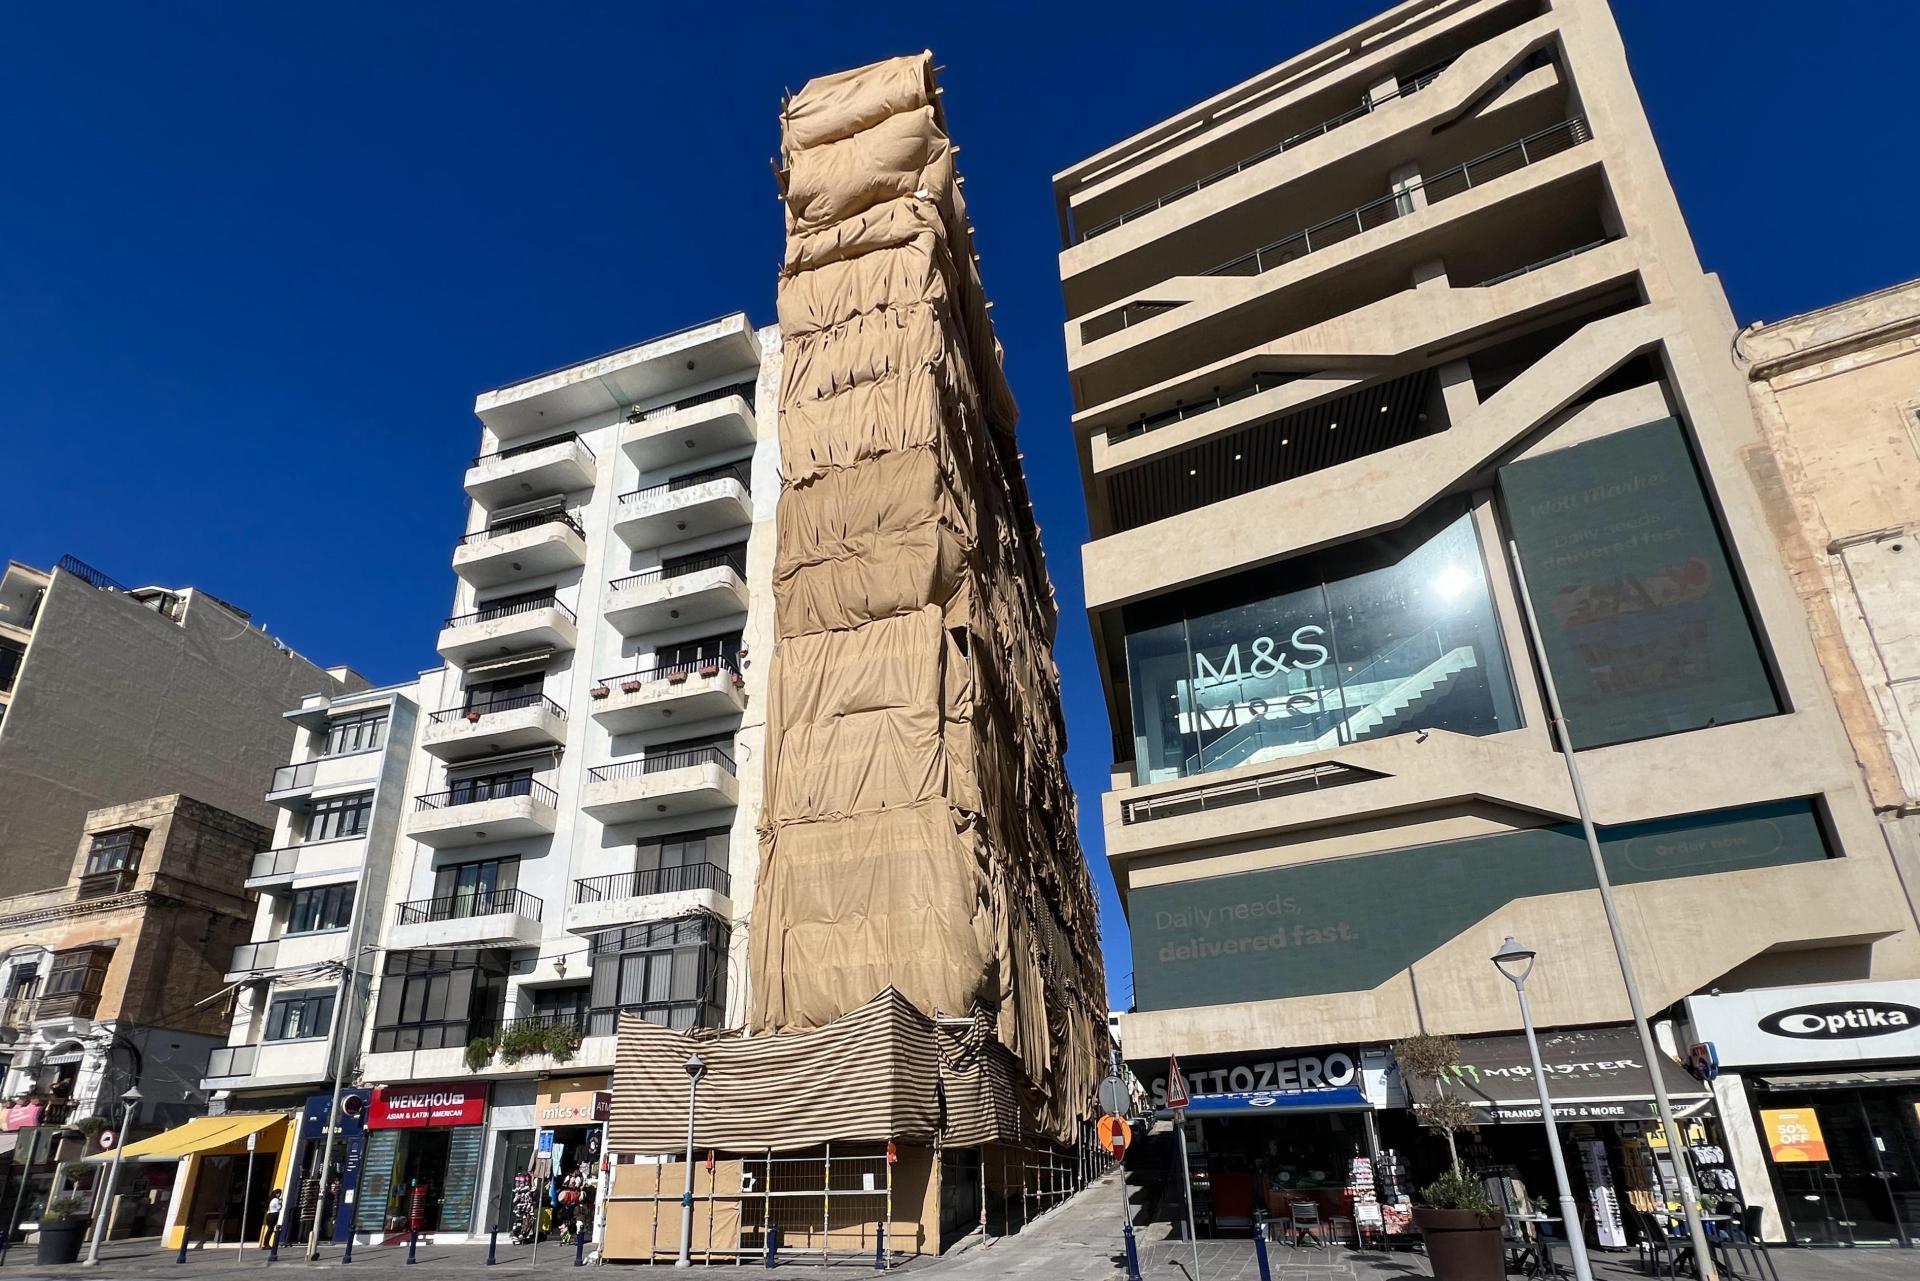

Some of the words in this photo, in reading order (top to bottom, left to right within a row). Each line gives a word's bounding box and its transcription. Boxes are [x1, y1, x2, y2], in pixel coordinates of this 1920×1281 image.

[1195, 624, 1328, 694] M&S
[1155, 906, 1214, 930] Daily
[1218, 893, 1302, 921] needs,
[1158, 927, 1287, 962] delivered
[1291, 921, 1359, 946] fast.
[1778, 1008, 1909, 1034] Optika
[389, 1092, 453, 1109] WENZHOU
[386, 1112, 405, 1120] ASIAN
[412, 1111, 429, 1119] LATIN
[431, 1109, 463, 1117] AMERICAN
[543, 1104, 573, 1119] mics
[1551, 1107, 1577, 1117] IFTS
[1579, 1107, 1588, 1116] &
[1592, 1106, 1625, 1116] MORE
[1651, 1130, 1667, 1140] AT
[1777, 1123, 1809, 1134] 50%
[1780, 1134, 1809, 1145] OFF
